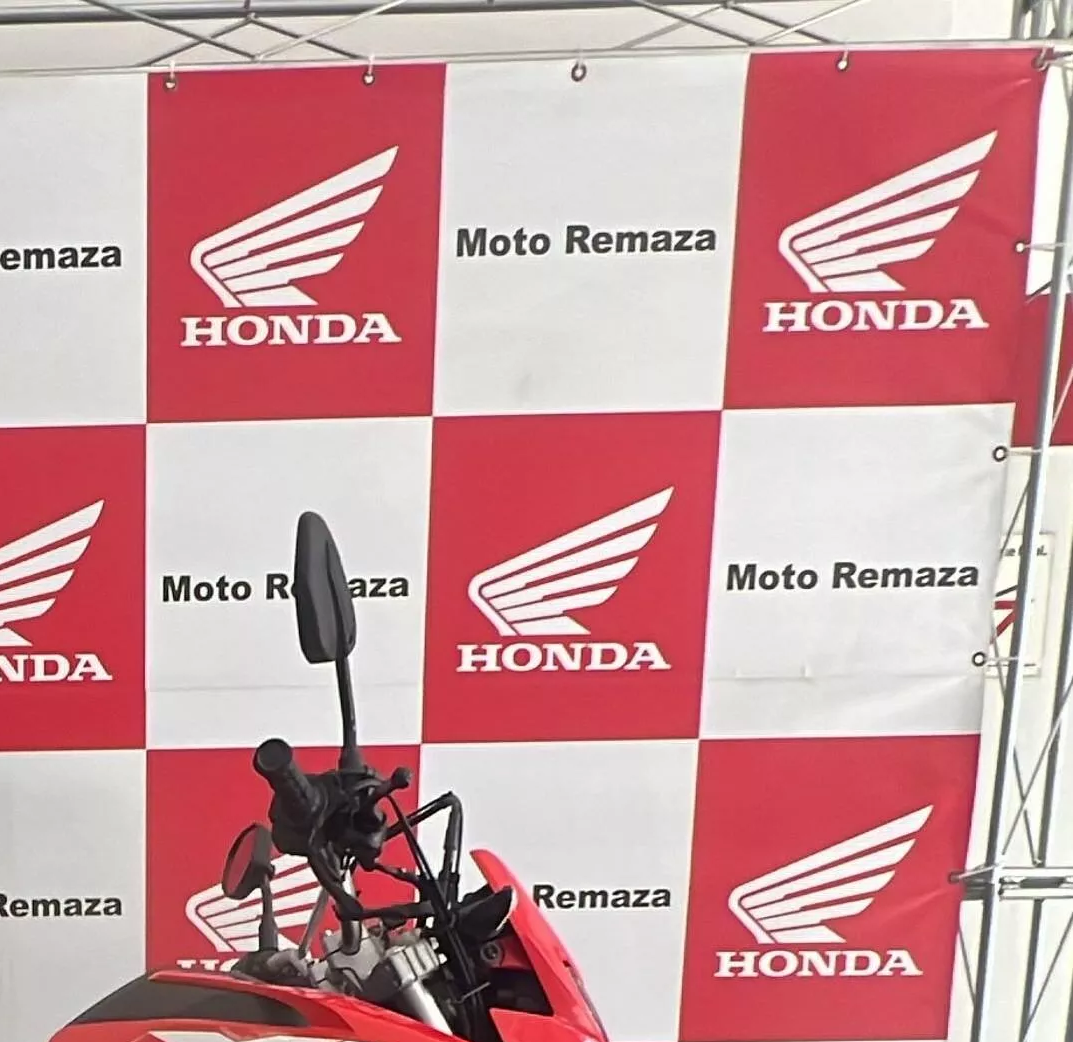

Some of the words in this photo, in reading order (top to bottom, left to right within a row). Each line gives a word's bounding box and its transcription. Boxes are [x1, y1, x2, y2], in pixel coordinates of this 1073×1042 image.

[457, 228, 551, 256] Moto
[566, 226, 716, 254] Remaza
[762, 299, 990, 332] HONDA
[180, 314, 402, 346] HONDA
[162, 575, 252, 602] Moto
[265, 574, 410, 600] Raza
[727, 564, 818, 591] Moto
[833, 563, 979, 589] Remaza
[456, 643, 672, 672] HONDA
[533, 884, 671, 909] Remaza
[715, 950, 924, 978] HONDA
